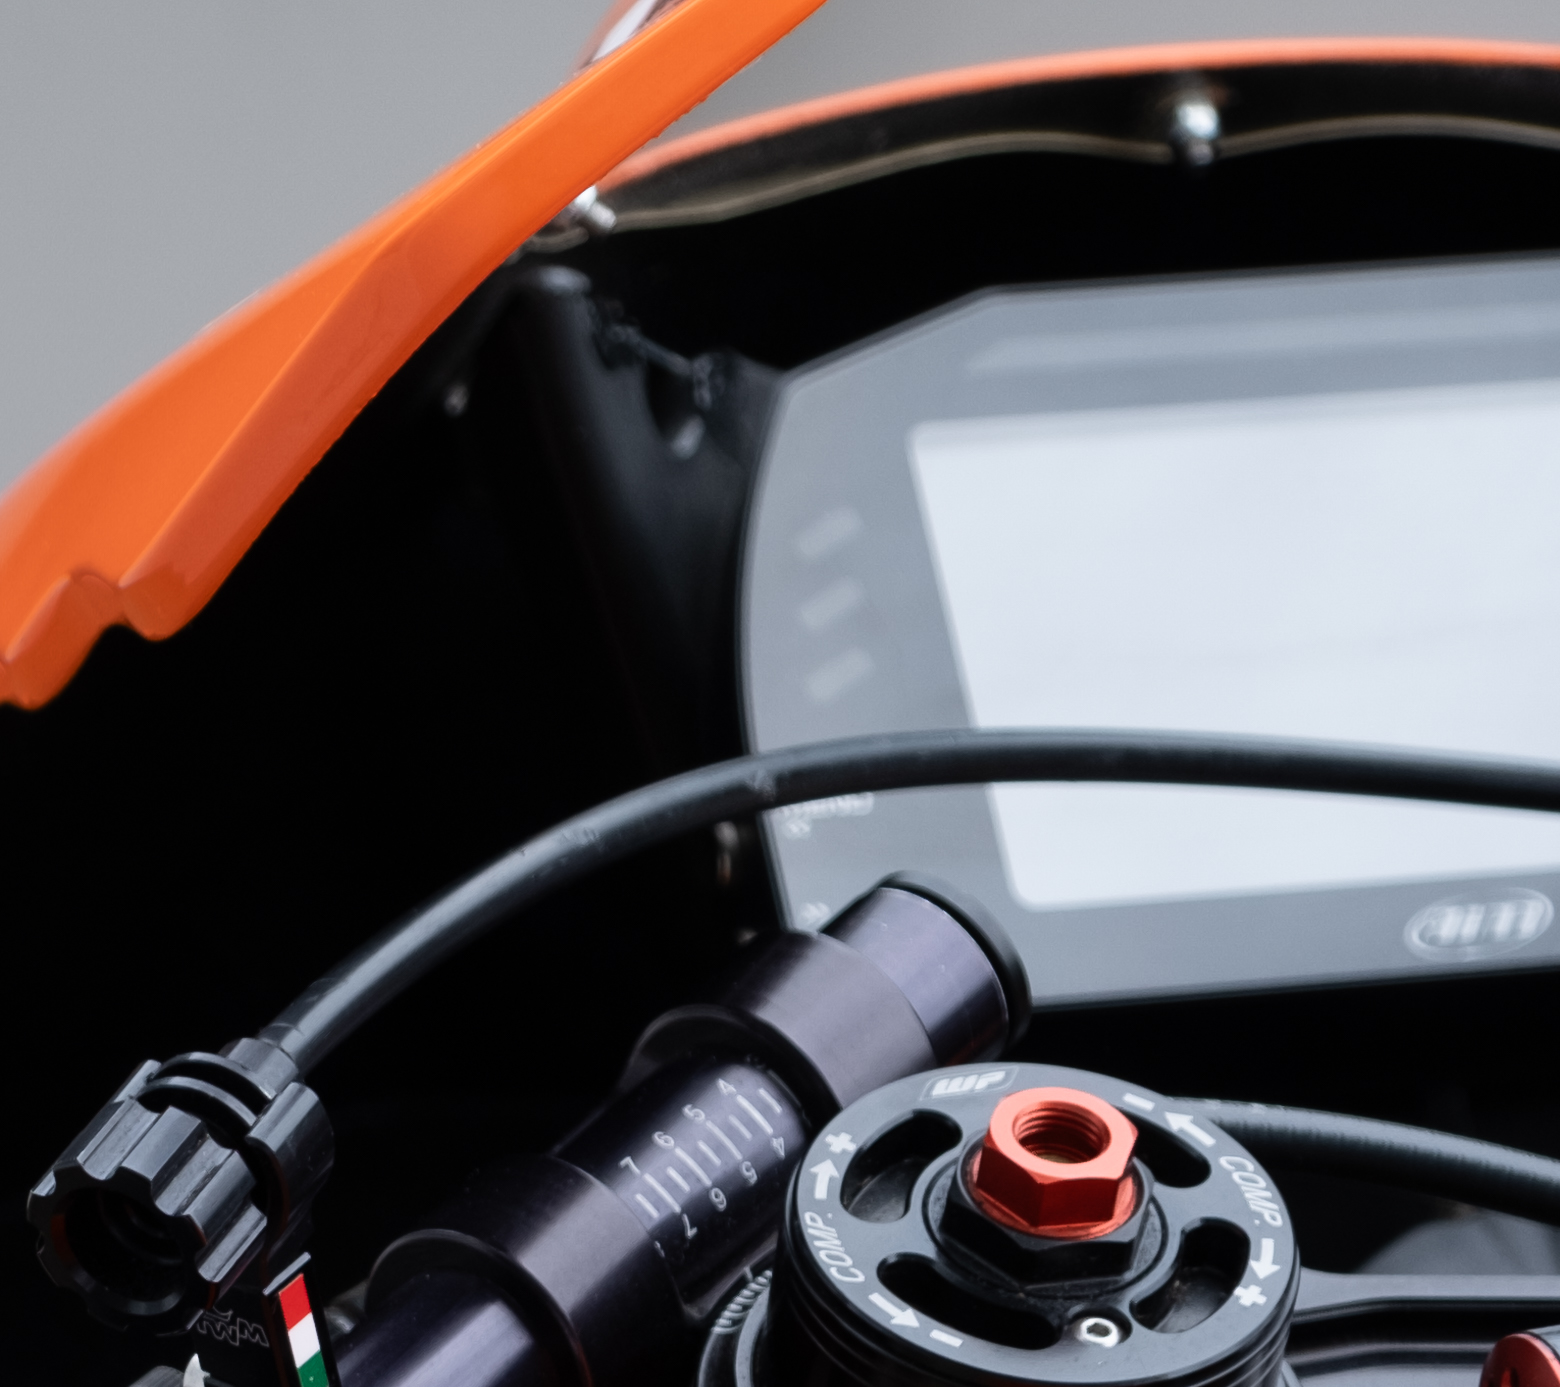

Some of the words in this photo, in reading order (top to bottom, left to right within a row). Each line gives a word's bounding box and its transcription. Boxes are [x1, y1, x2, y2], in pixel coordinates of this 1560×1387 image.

[932, 1070, 1007, 1097] WP
[619, 1156, 641, 1175] 7
[652, 1131, 675, 1149] 6
[682, 1104, 705, 1122] 5
[717, 1078, 737, 1095] 4
[740, 1160, 758, 1186] 5
[1219, 1155, 1284, 1228] COMP.
[682, 1214, 698, 1239] 7
[804, 1211, 866, 1284] COMP.
